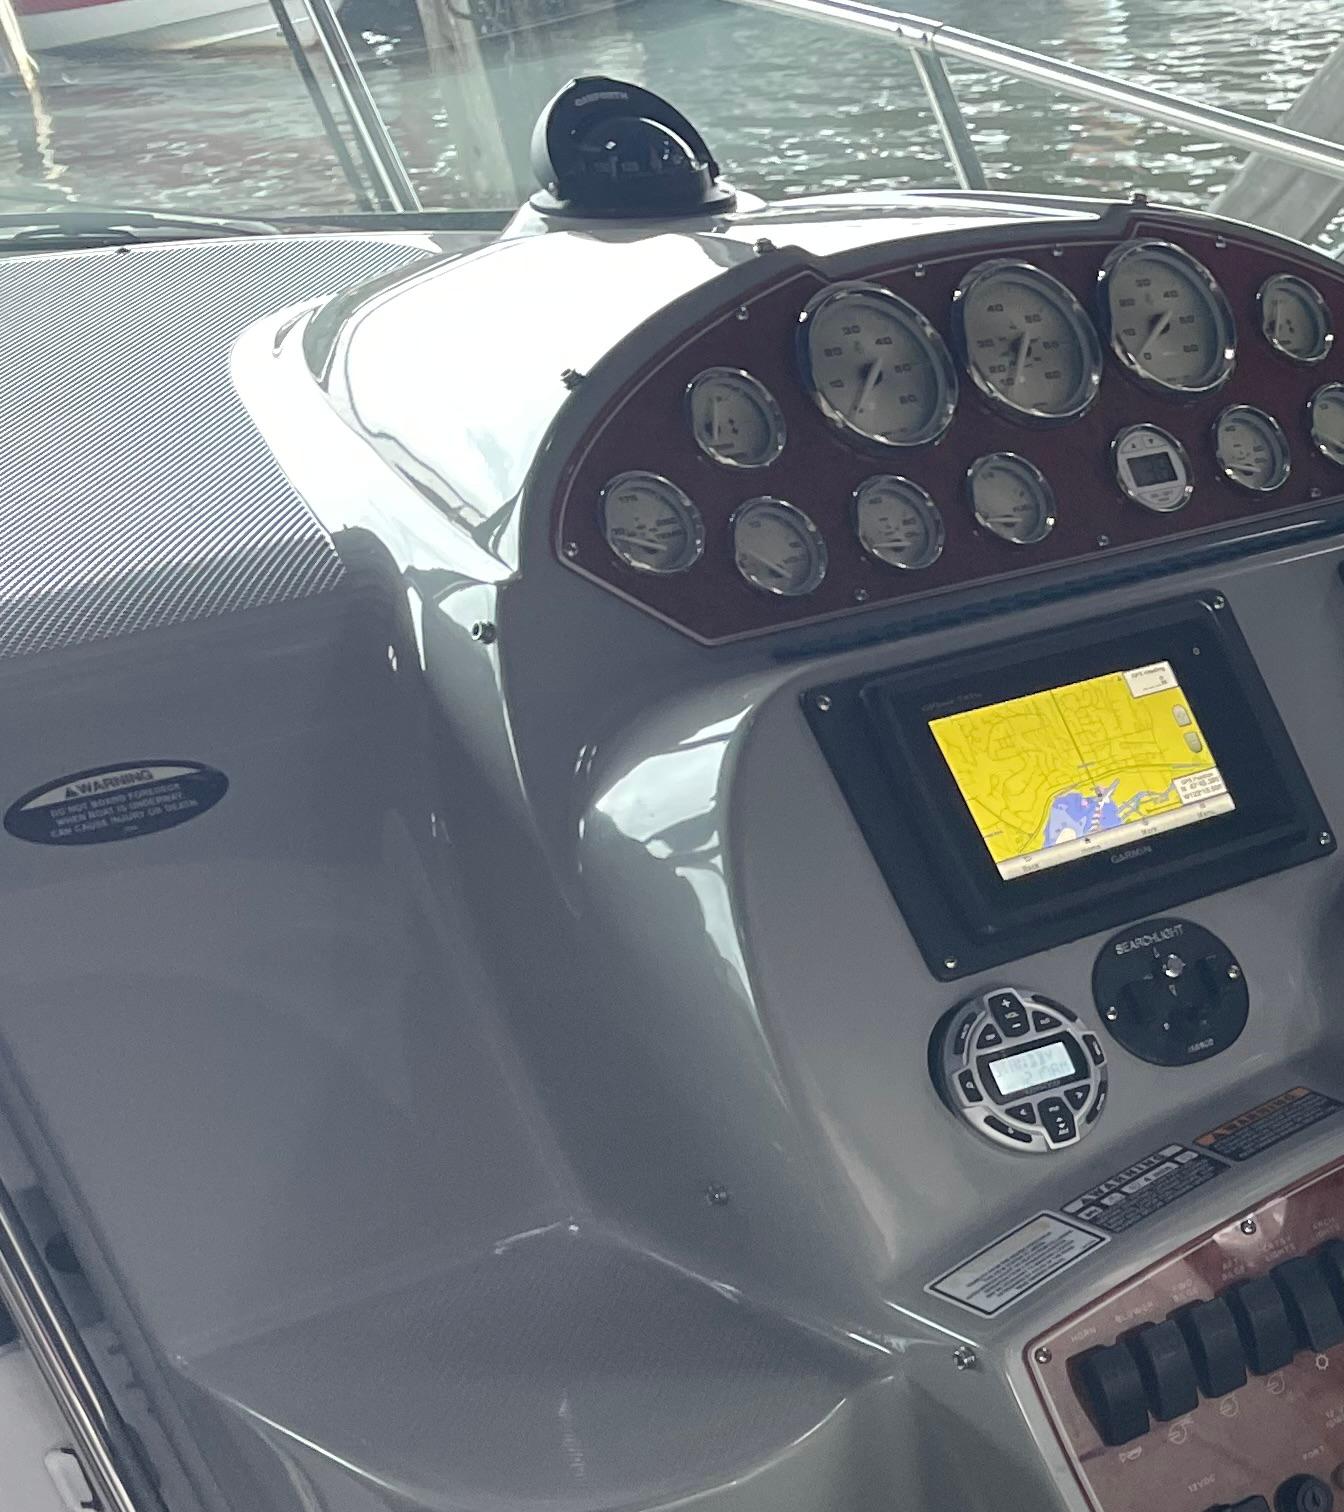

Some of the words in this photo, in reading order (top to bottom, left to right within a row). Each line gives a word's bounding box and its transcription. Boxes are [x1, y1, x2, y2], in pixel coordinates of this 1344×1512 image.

[1163, 290, 1178, 298] 40
[987, 303, 1004, 313] 40
[842, 325, 861, 336] 30
[875, 336, 893, 345] 40
[77, 769, 154, 794] WARNING
[1110, 847, 1153, 864] GARMIN
[1115, 924, 1183, 955] SEARCHLIGHT
[1090, 1153, 1162, 1197] WARNING
[1071, 1326, 1097, 1343] HORN
[1302, 1445, 1325, 1460] PORT
